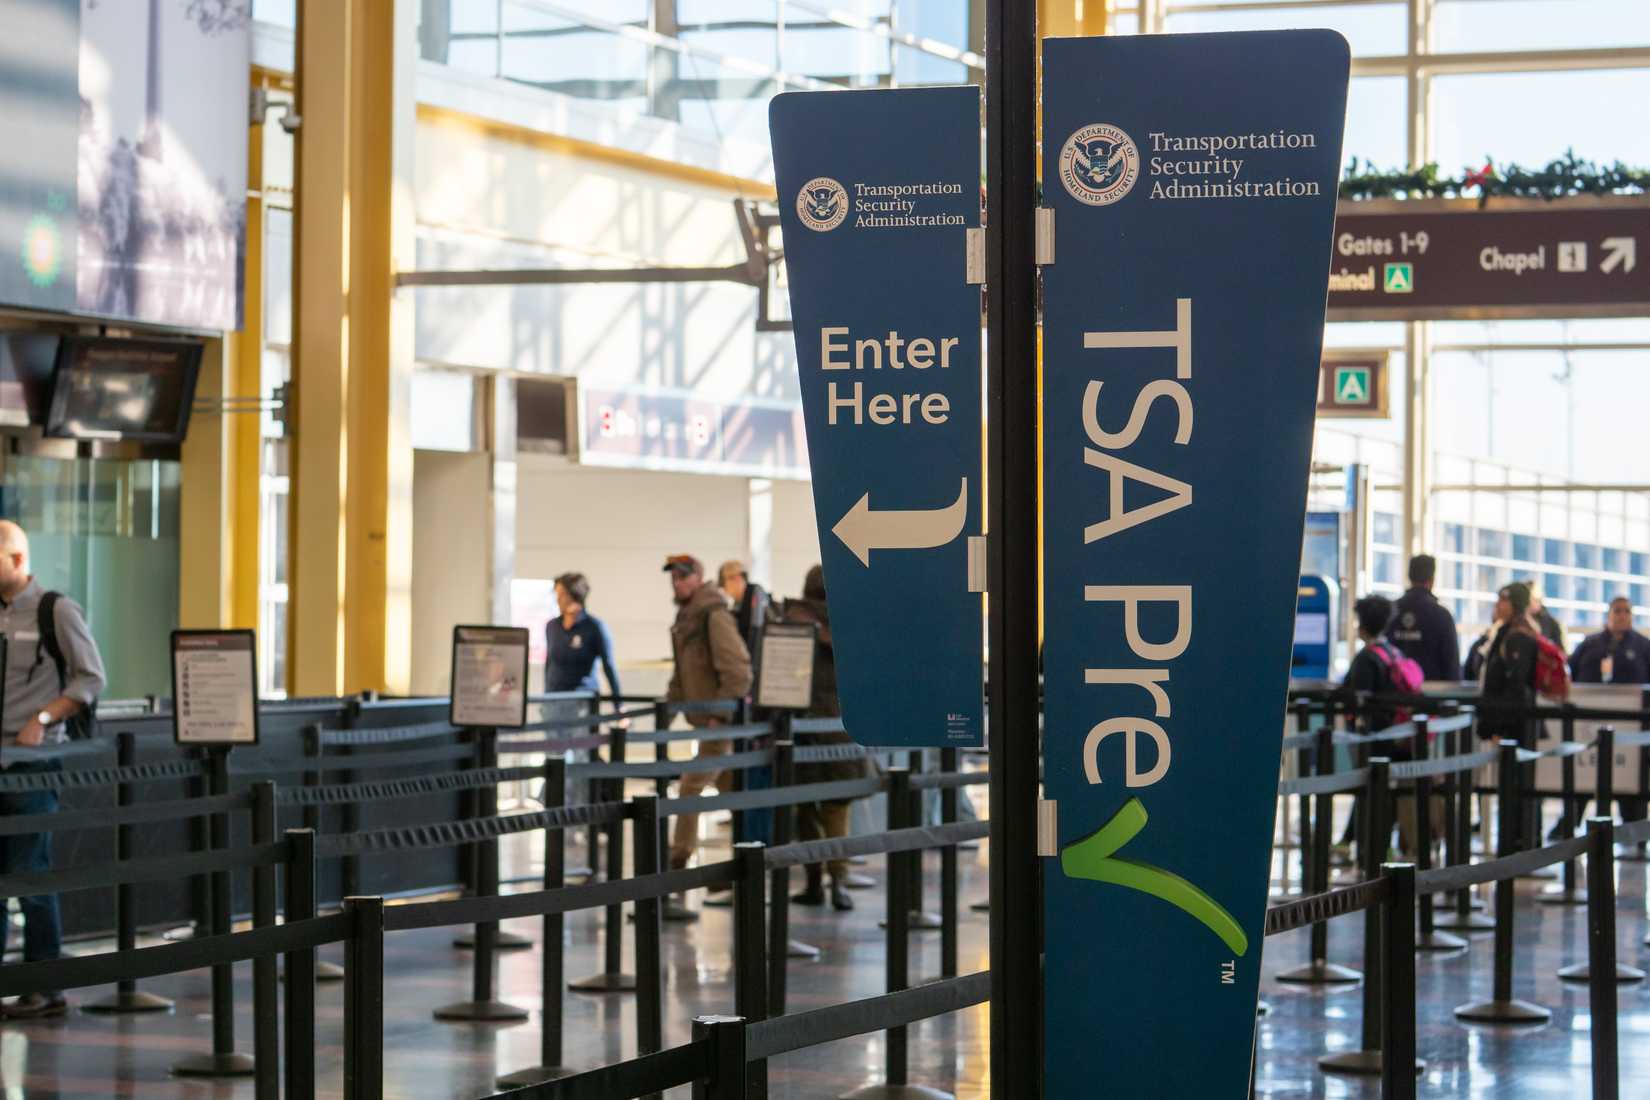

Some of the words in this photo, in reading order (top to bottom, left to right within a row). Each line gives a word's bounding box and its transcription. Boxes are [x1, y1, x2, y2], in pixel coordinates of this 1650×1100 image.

[1075, 127, 1129, 147] DEPARTMENT
[1149, 129, 1317, 155] Transportation
[1149, 156, 1243, 179] Security
[854, 181, 962, 199] Transportation
[1063, 168, 1101, 202] HOMELAND
[1103, 167, 1135, 201] SECURITY
[1149, 178, 1320, 200] Administration
[855, 198, 916, 215] Security
[855, 212, 966, 228] Administration
[1338, 232, 1393, 256] Gates
[1399, 230, 1430, 255] 1-9
[1480, 245, 1546, 276] Chapel
[1327, 265, 1376, 292] minal
[1387, 265, 1411, 291] A
[821, 326, 959, 370] Enter
[1338, 369, 1366, 402] A
[828, 381, 950, 425] Here
[1082, 297, 1194, 545] TSA
[1083, 585, 1193, 788] Pre
[1221, 959, 1235, 984] TM
